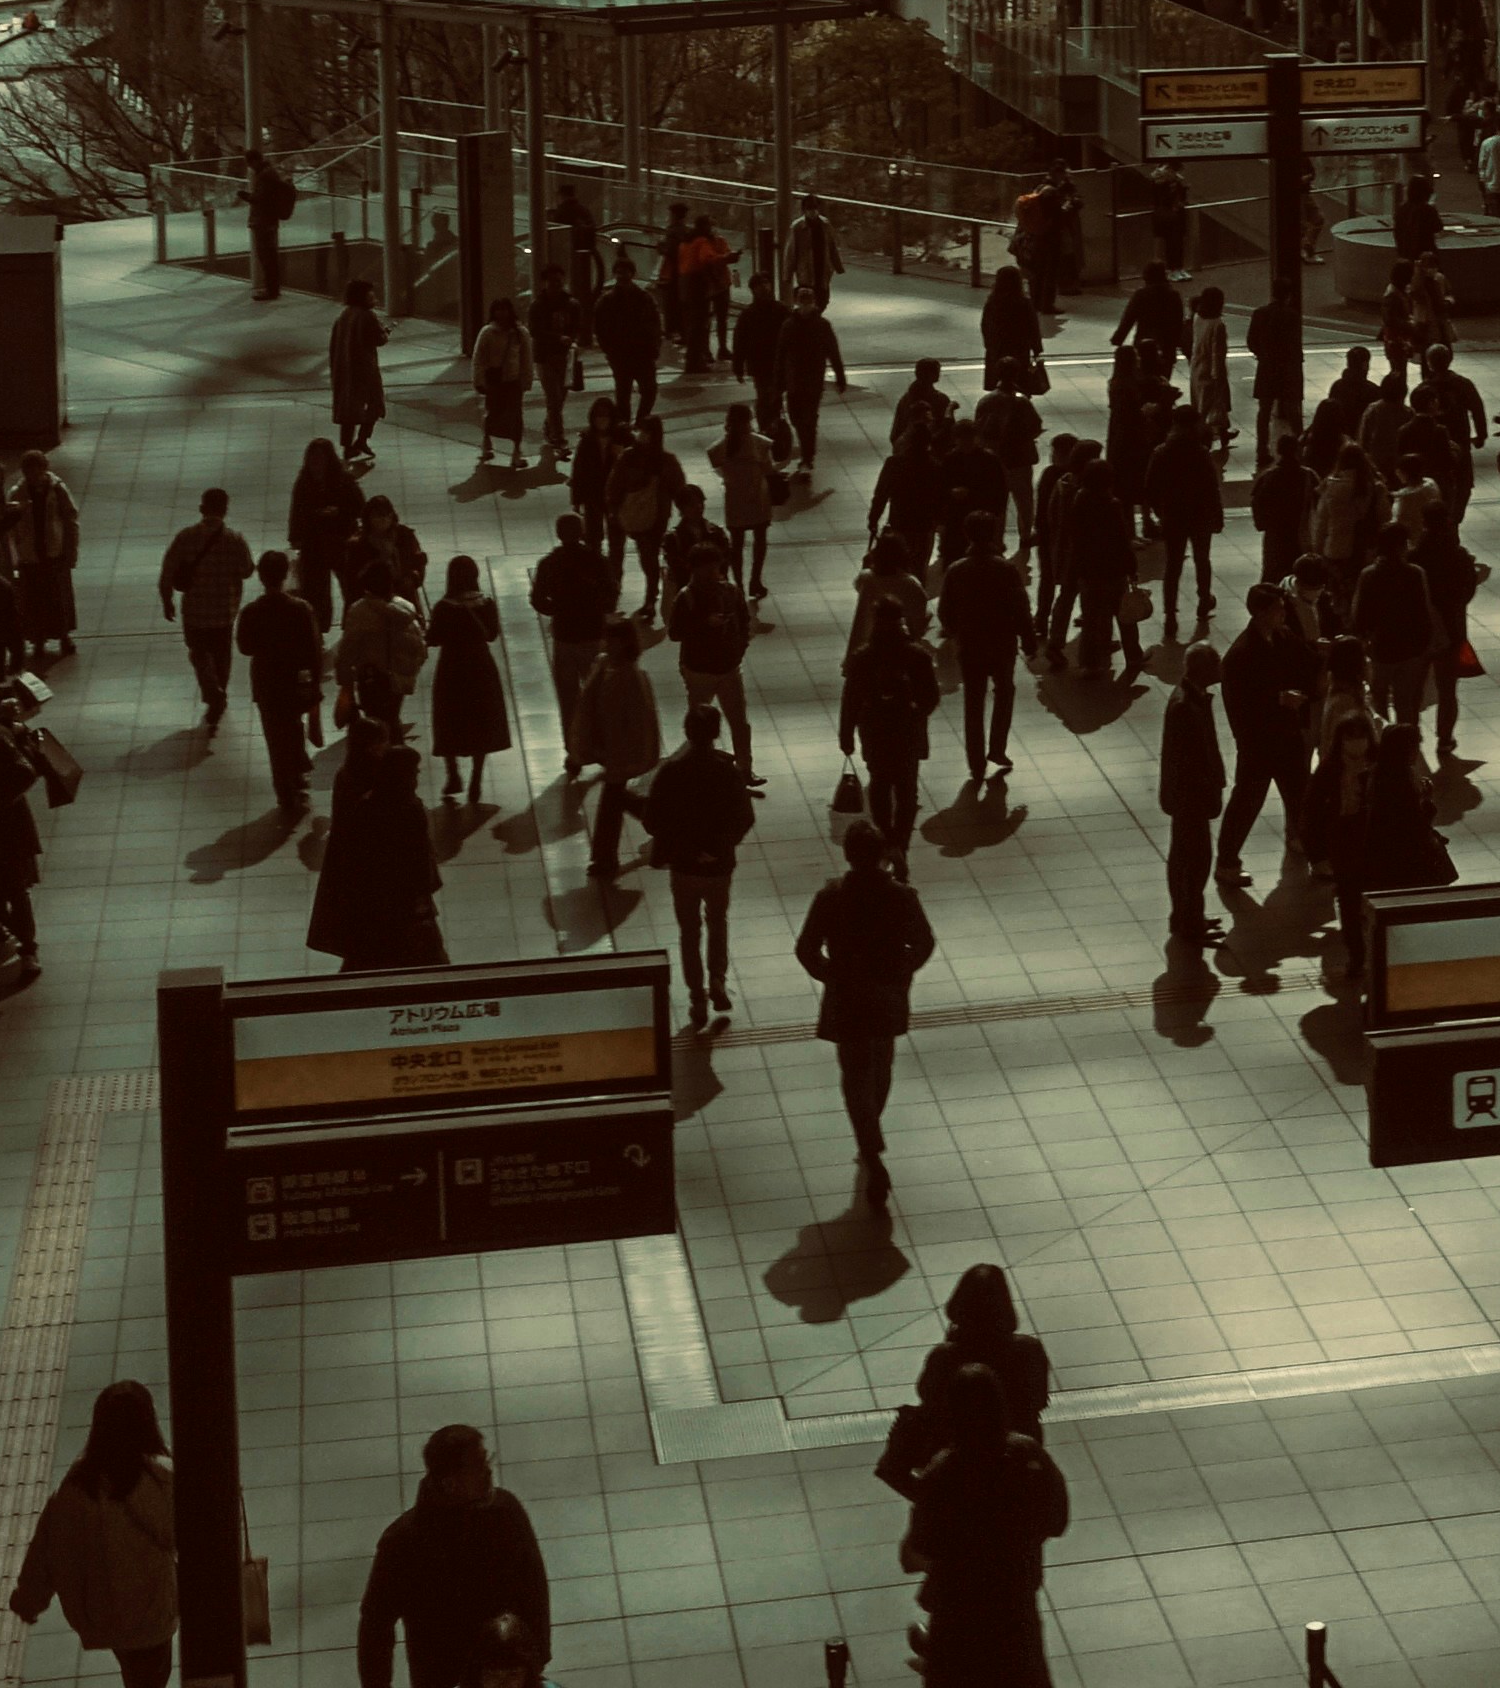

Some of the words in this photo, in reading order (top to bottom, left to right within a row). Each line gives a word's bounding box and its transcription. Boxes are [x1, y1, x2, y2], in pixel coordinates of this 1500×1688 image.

[389, 1001, 501, 1023] アトリウム広場
[390, 1050, 463, 1070] 中央北口
